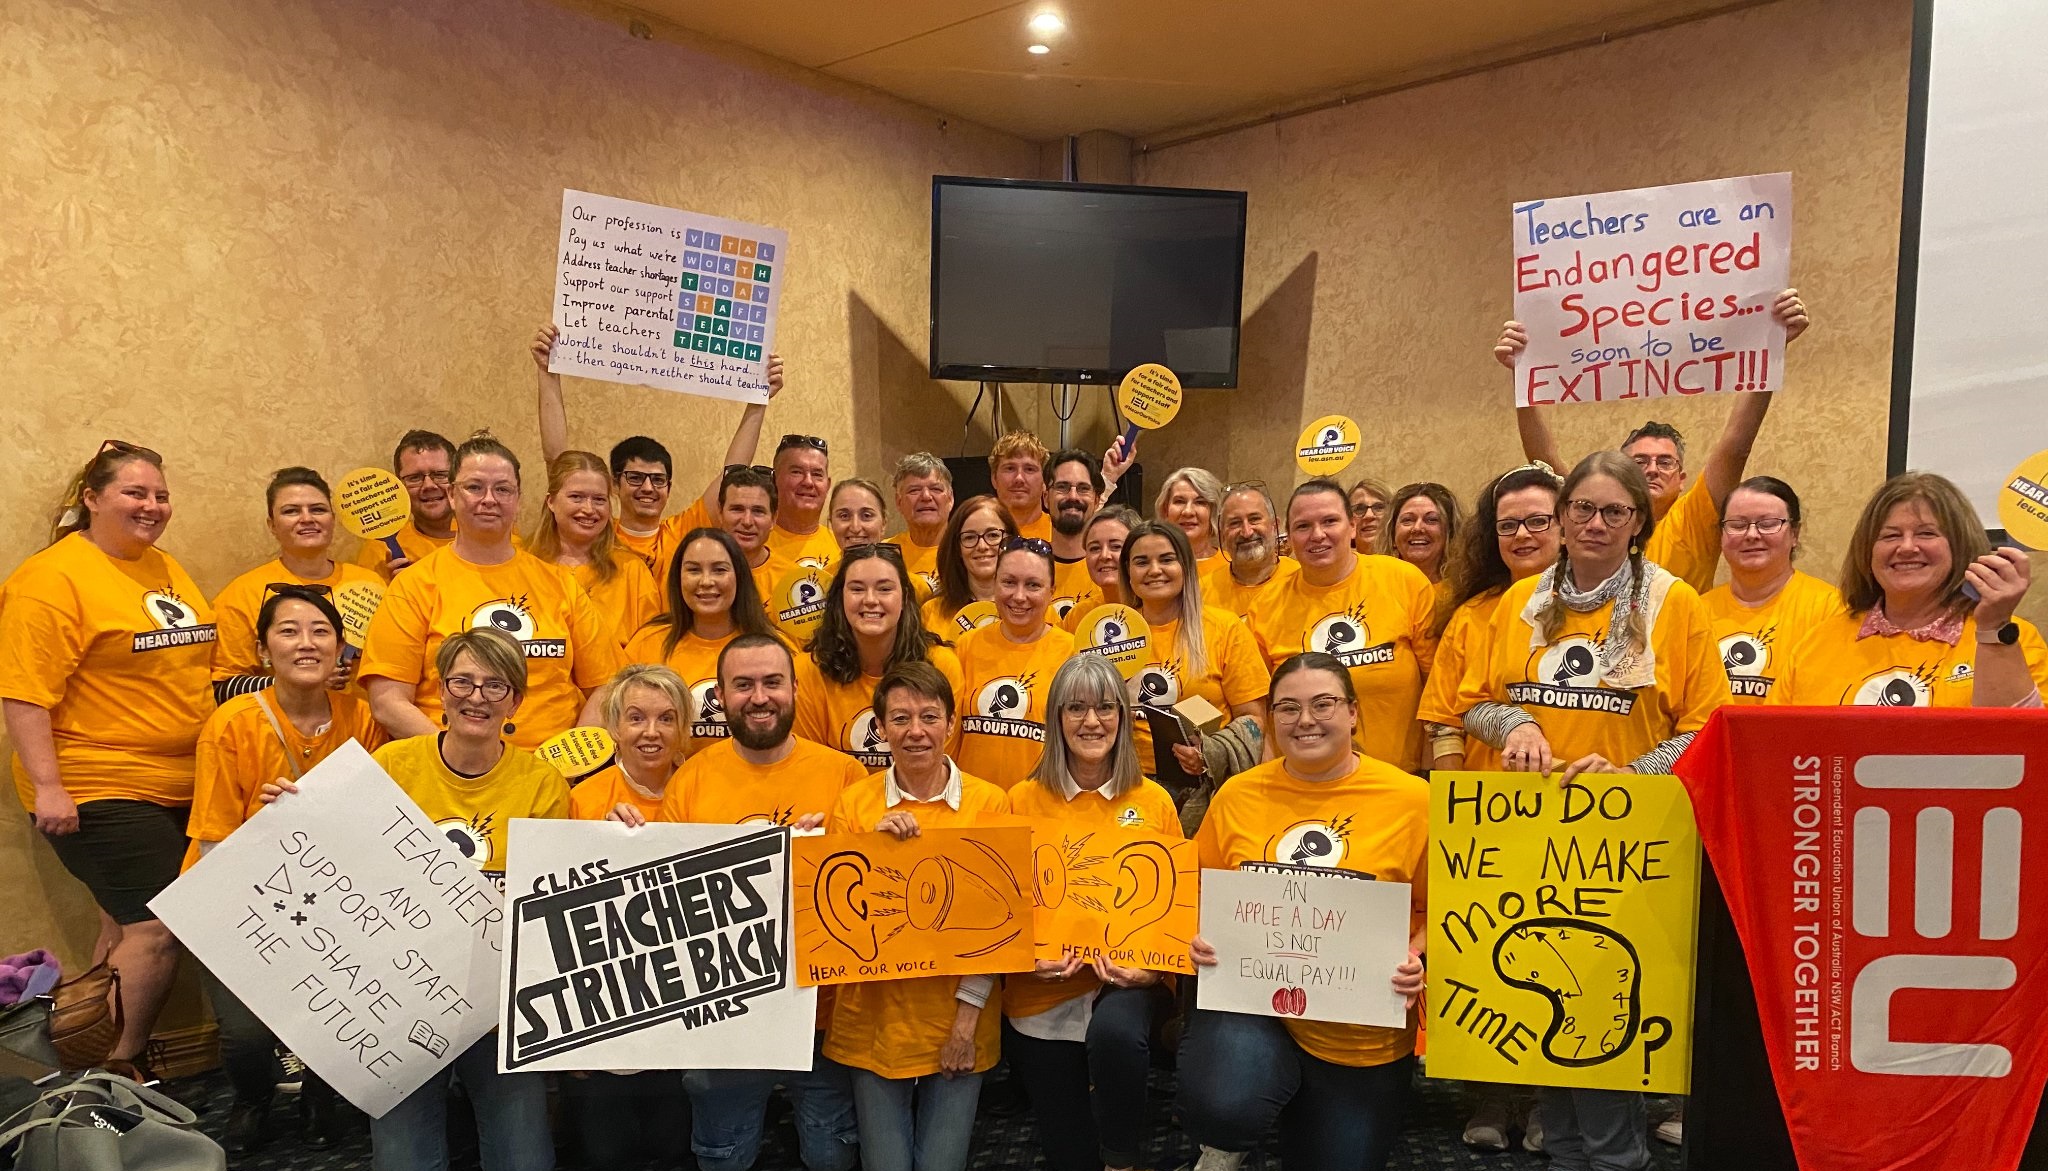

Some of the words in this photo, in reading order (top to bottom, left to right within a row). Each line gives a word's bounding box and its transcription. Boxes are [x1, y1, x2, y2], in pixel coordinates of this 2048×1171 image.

[573, 206, 596, 223] Our
[605, 217, 663, 234] profession
[671, 227, 681, 240] is
[691, 234, 768, 257] VITAL
[1515, 201, 1649, 245] Teachers
[1679, 207, 1720, 227] are
[1740, 202, 1774, 219] an
[568, 228, 586, 250] Pay
[593, 240, 605, 248] us
[615, 241, 642, 256] what
[650, 250, 676, 263] we're
[687, 256, 766, 278] WORTH
[1517, 232, 1760, 292] Endangered
[563, 252, 600, 270] Address
[605, 259, 637, 275] teacher
[640, 266, 678, 290] shortages
[687, 278, 765, 299] TODAY
[563, 272, 604, 291] Support
[611, 284, 630, 294] our
[636, 285, 673, 305] support
[684, 297, 761, 318] STAFF
[562, 294, 614, 312] Improve
[625, 306, 674, 322] parental
[681, 318, 758, 338] LEAVE
[1560, 293, 1764, 344] Species...
[565, 314, 586, 328] Let
[599, 317, 660, 340] teachers
[680, 336, 757, 357] TEACH
[1571, 347, 1630, 364] soon
[1640, 330, 1672, 357] to
[1689, 333, 1725, 352] be
[558, 334, 602, 351] Wordle
[613, 343, 666, 359] shouldn't
[674, 352, 685, 363] be
[691, 356, 714, 369] this
[611, 359, 648, 375] again,
[652, 366, 694, 380] neither
[700, 372, 732, 386] should
[737, 377, 769, 395] teaching
[1153, 380, 1163, 388] fair
[1164, 385, 1177, 395] deal
[1160, 374, 1173, 384] time
[1131, 396, 1148, 410] IEU
[1132, 388, 1154, 401] support
[1155, 400, 1170, 409] staff
[1141, 383, 1165, 399] teachers
[1166, 395, 1178, 404] and
[360, 474, 376, 482] time
[374, 477, 390, 487] deal
[2011, 479, 2044, 500] HEAR
[351, 502, 379, 515] support
[380, 494, 397, 504] staff
[353, 490, 384, 505] teachers
[386, 484, 399, 492] and
[360, 511, 381, 525] IEU
[349, 588, 360, 597] for
[342, 613, 363, 629] IEU
[780, 610, 801, 620] HEAR
[801, 605, 817, 614] OUR
[958, 616, 973, 631] HEA
[135, 634, 170, 650] HEAR
[170, 631, 191, 644] OUR
[522, 645, 564, 656] VOICE
[1103, 645, 1120, 655] OUR
[1121, 640, 1145, 651] VOICE
[1353, 649, 1394, 666] VOICE
[1507, 687, 1541, 703] HEAR
[1543, 690, 1578, 708] OUR
[1581, 693, 1632, 714] VOICE
[696, 726, 724, 736] OUR
[983, 721, 1009, 735] OUR
[858, 756, 886, 765] OUR
[1559, 783, 1632, 823] DO
[1832, 756, 1843, 826] Independent
[1793, 755, 1821, 912] STRONGER
[1439, 837, 1502, 879] WE
[1541, 836, 1669, 883] MAKE
[1832, 830, 1843, 883] Education
[532, 859, 608, 895] CLASS
[624, 865, 673, 892] THE
[1283, 880, 1306, 903] AN
[1832, 887, 1843, 916] Union
[380, 887, 431, 929] AND
[522, 859, 771, 974] TEACHERS
[1234, 900, 1283, 927] APPLE
[1292, 906, 1301, 927] A
[1313, 907, 1347, 932] DAY
[1441, 885, 1622, 953] MORE
[1851, 754, 2025, 1078] IEU
[237, 905, 290, 964] THE
[280, 831, 396, 937] SUPPORT
[392, 949, 472, 1016] STAFF
[1832, 921, 1842, 929] of
[1061, 944, 1101, 959] HEAR
[1109, 948, 1134, 962] OUR
[1141, 953, 1186, 967] VOICE
[1266, 932, 1285, 949] IS
[1291, 934, 1321, 953] NOT
[1594, 936, 1608, 949] 2
[1831, 933, 1843, 978] Australia
[302, 927, 402, 1024] SHAPE
[517, 947, 687, 1048] STRIKE
[687, 920, 782, 994] BACK
[810, 963, 848, 981] HEAR
[859, 965, 891, 975] OUR
[896, 960, 938, 972] VOICE
[1241, 958, 1293, 984] EQUAL
[1617, 969, 1628, 983] 3
[1613, 992, 1630, 1008] 4
[1794, 922, 1820, 1071] TOGETHER
[1831, 982, 1842, 1030] NSW/ACT
[679, 998, 748, 1030] WARS
[1439, 978, 1537, 1065] TIME
[1562, 1017, 1575, 1034] 8
[1614, 1013, 1628, 1030] 5
[1574, 1036, 1586, 1058] 7
[1601, 1030, 1615, 1054] 6
[1831, 1034, 1841, 1071] Branch
